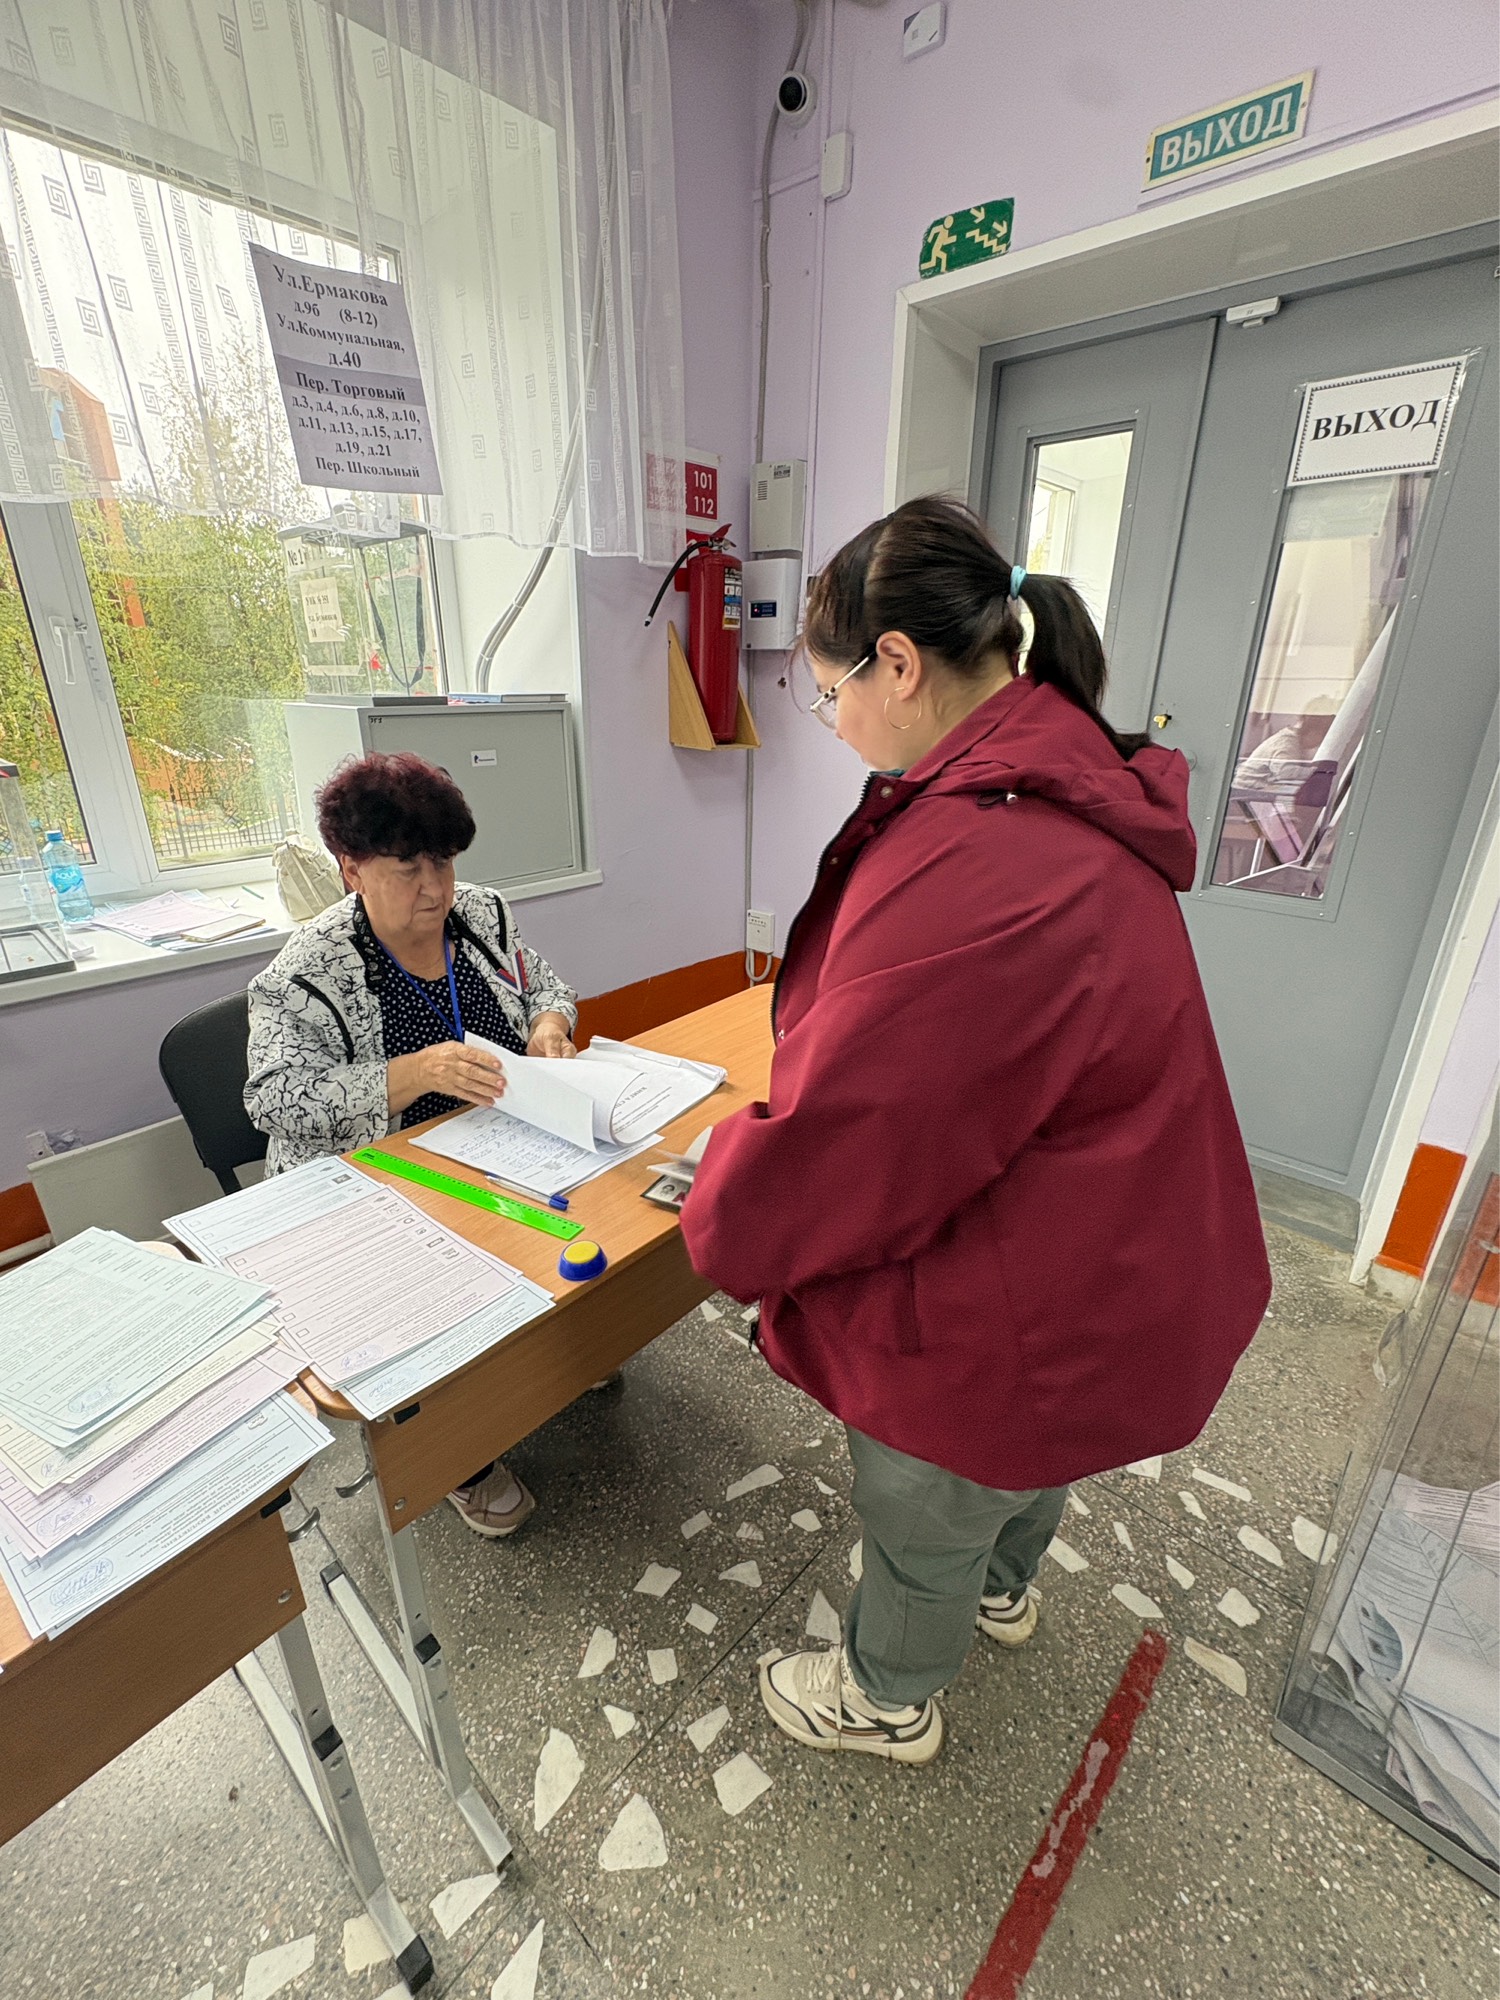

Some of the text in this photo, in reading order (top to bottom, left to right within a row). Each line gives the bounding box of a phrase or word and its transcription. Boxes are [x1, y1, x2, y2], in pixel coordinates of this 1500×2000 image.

[1160, 92, 1293, 173] ВЫХОД
[273, 264, 388, 306] Ул.Ермакова
[339, 308, 378, 329] (8-12)
[328, 351, 362, 368] д.40
[295, 372, 406, 400] Пер. Торговый
[292, 395, 421, 424] д.3, д.4, д.6, д.8, д.10,
[1310, 399, 1442, 441] ВЫХОД
[298, 416, 422, 443] д.11, д.13, д.15, д.17,
[335, 441, 392, 457] д.19, д.21
[315, 457, 421, 478] Пер. Школьный
[694, 470, 712, 490] 101
[694, 495, 714, 515] 112
